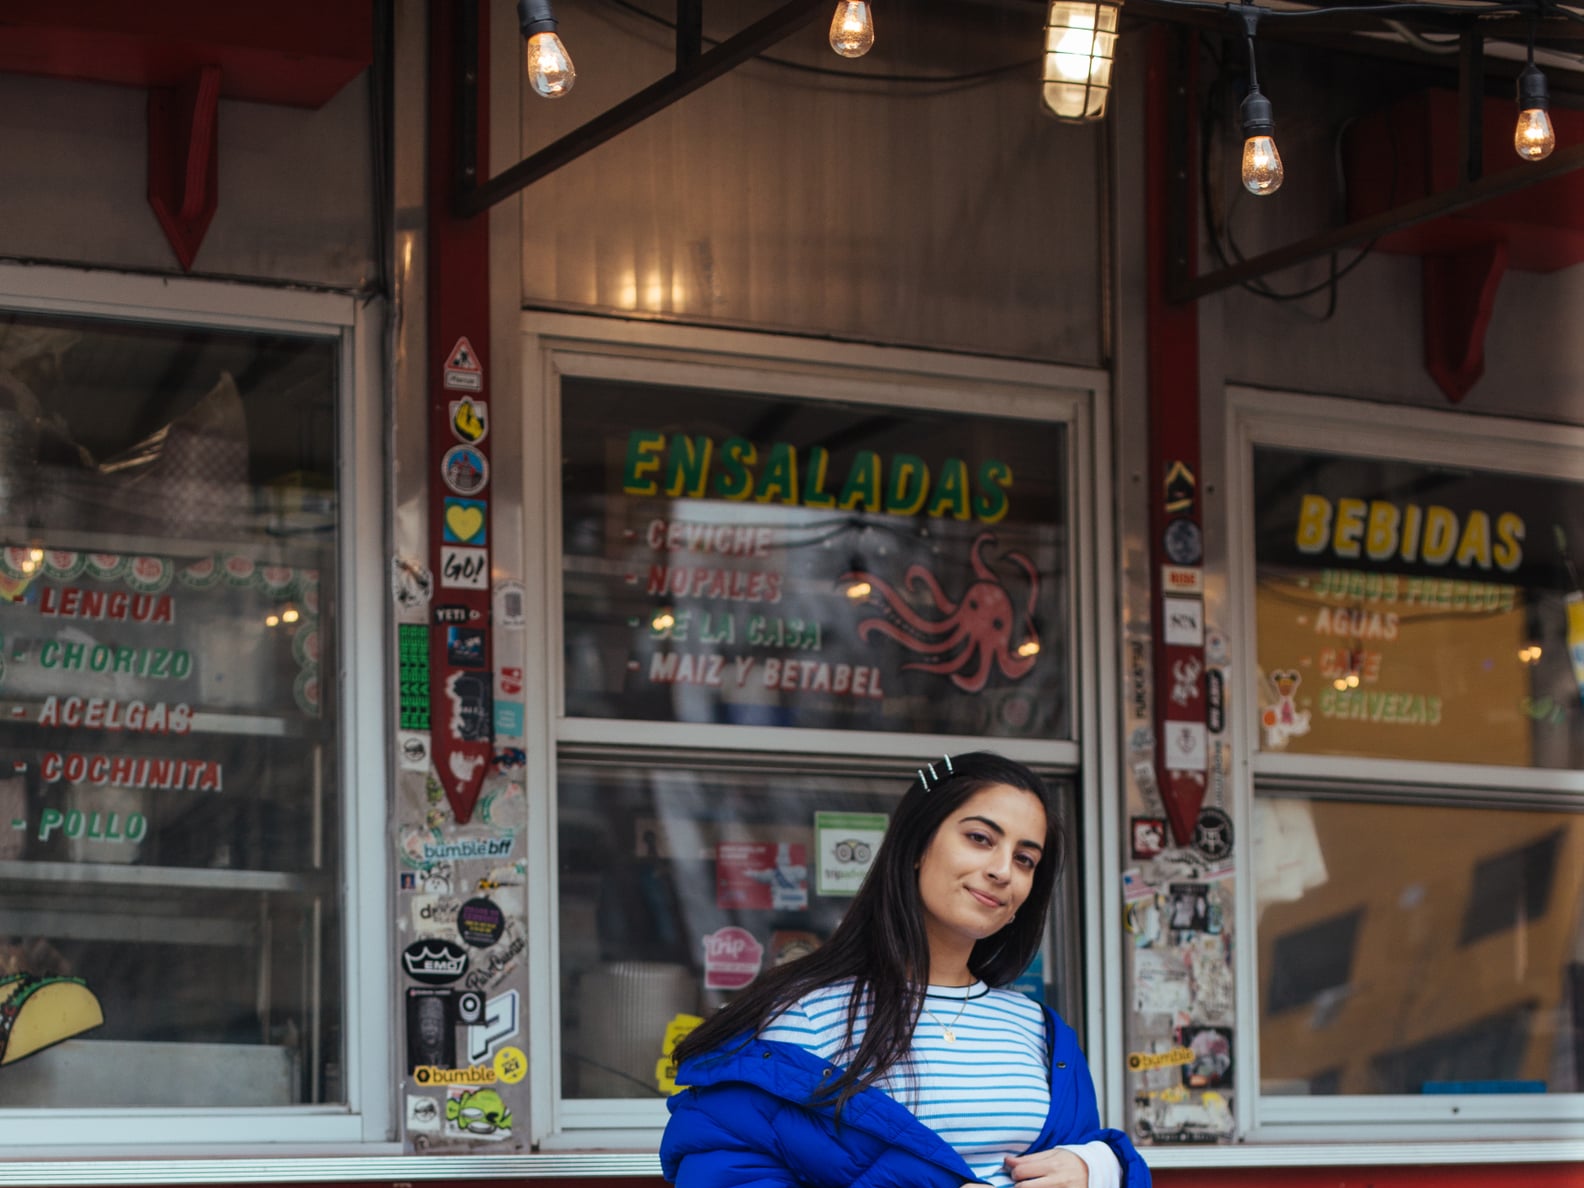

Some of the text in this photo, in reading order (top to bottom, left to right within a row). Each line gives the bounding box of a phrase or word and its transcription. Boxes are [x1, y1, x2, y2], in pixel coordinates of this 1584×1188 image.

[623, 430, 1013, 524] ENSALADAS
[647, 518, 774, 557] CEVICHE
[1296, 494, 1526, 571] BEBIDAS
[647, 565, 783, 603] NOPALES
[40, 587, 175, 625] LENGUA
[436, 608, 466, 622] YETI
[1314, 606, 1399, 641] AGUAS
[699, 611, 736, 645] LA
[747, 615, 822, 651] CASA
[40, 640, 192, 679] CHORIZO
[649, 652, 884, 696] MAIZ Y BETABEL
[38, 696, 195, 736] ACELGAS
[1318, 689, 1443, 726] CERVEZAS
[40, 752, 224, 791] COCHINITA
[38, 808, 147, 843] POLLO
[424, 838, 513, 859] bumble bff
[432, 1066, 496, 1084] bumble
